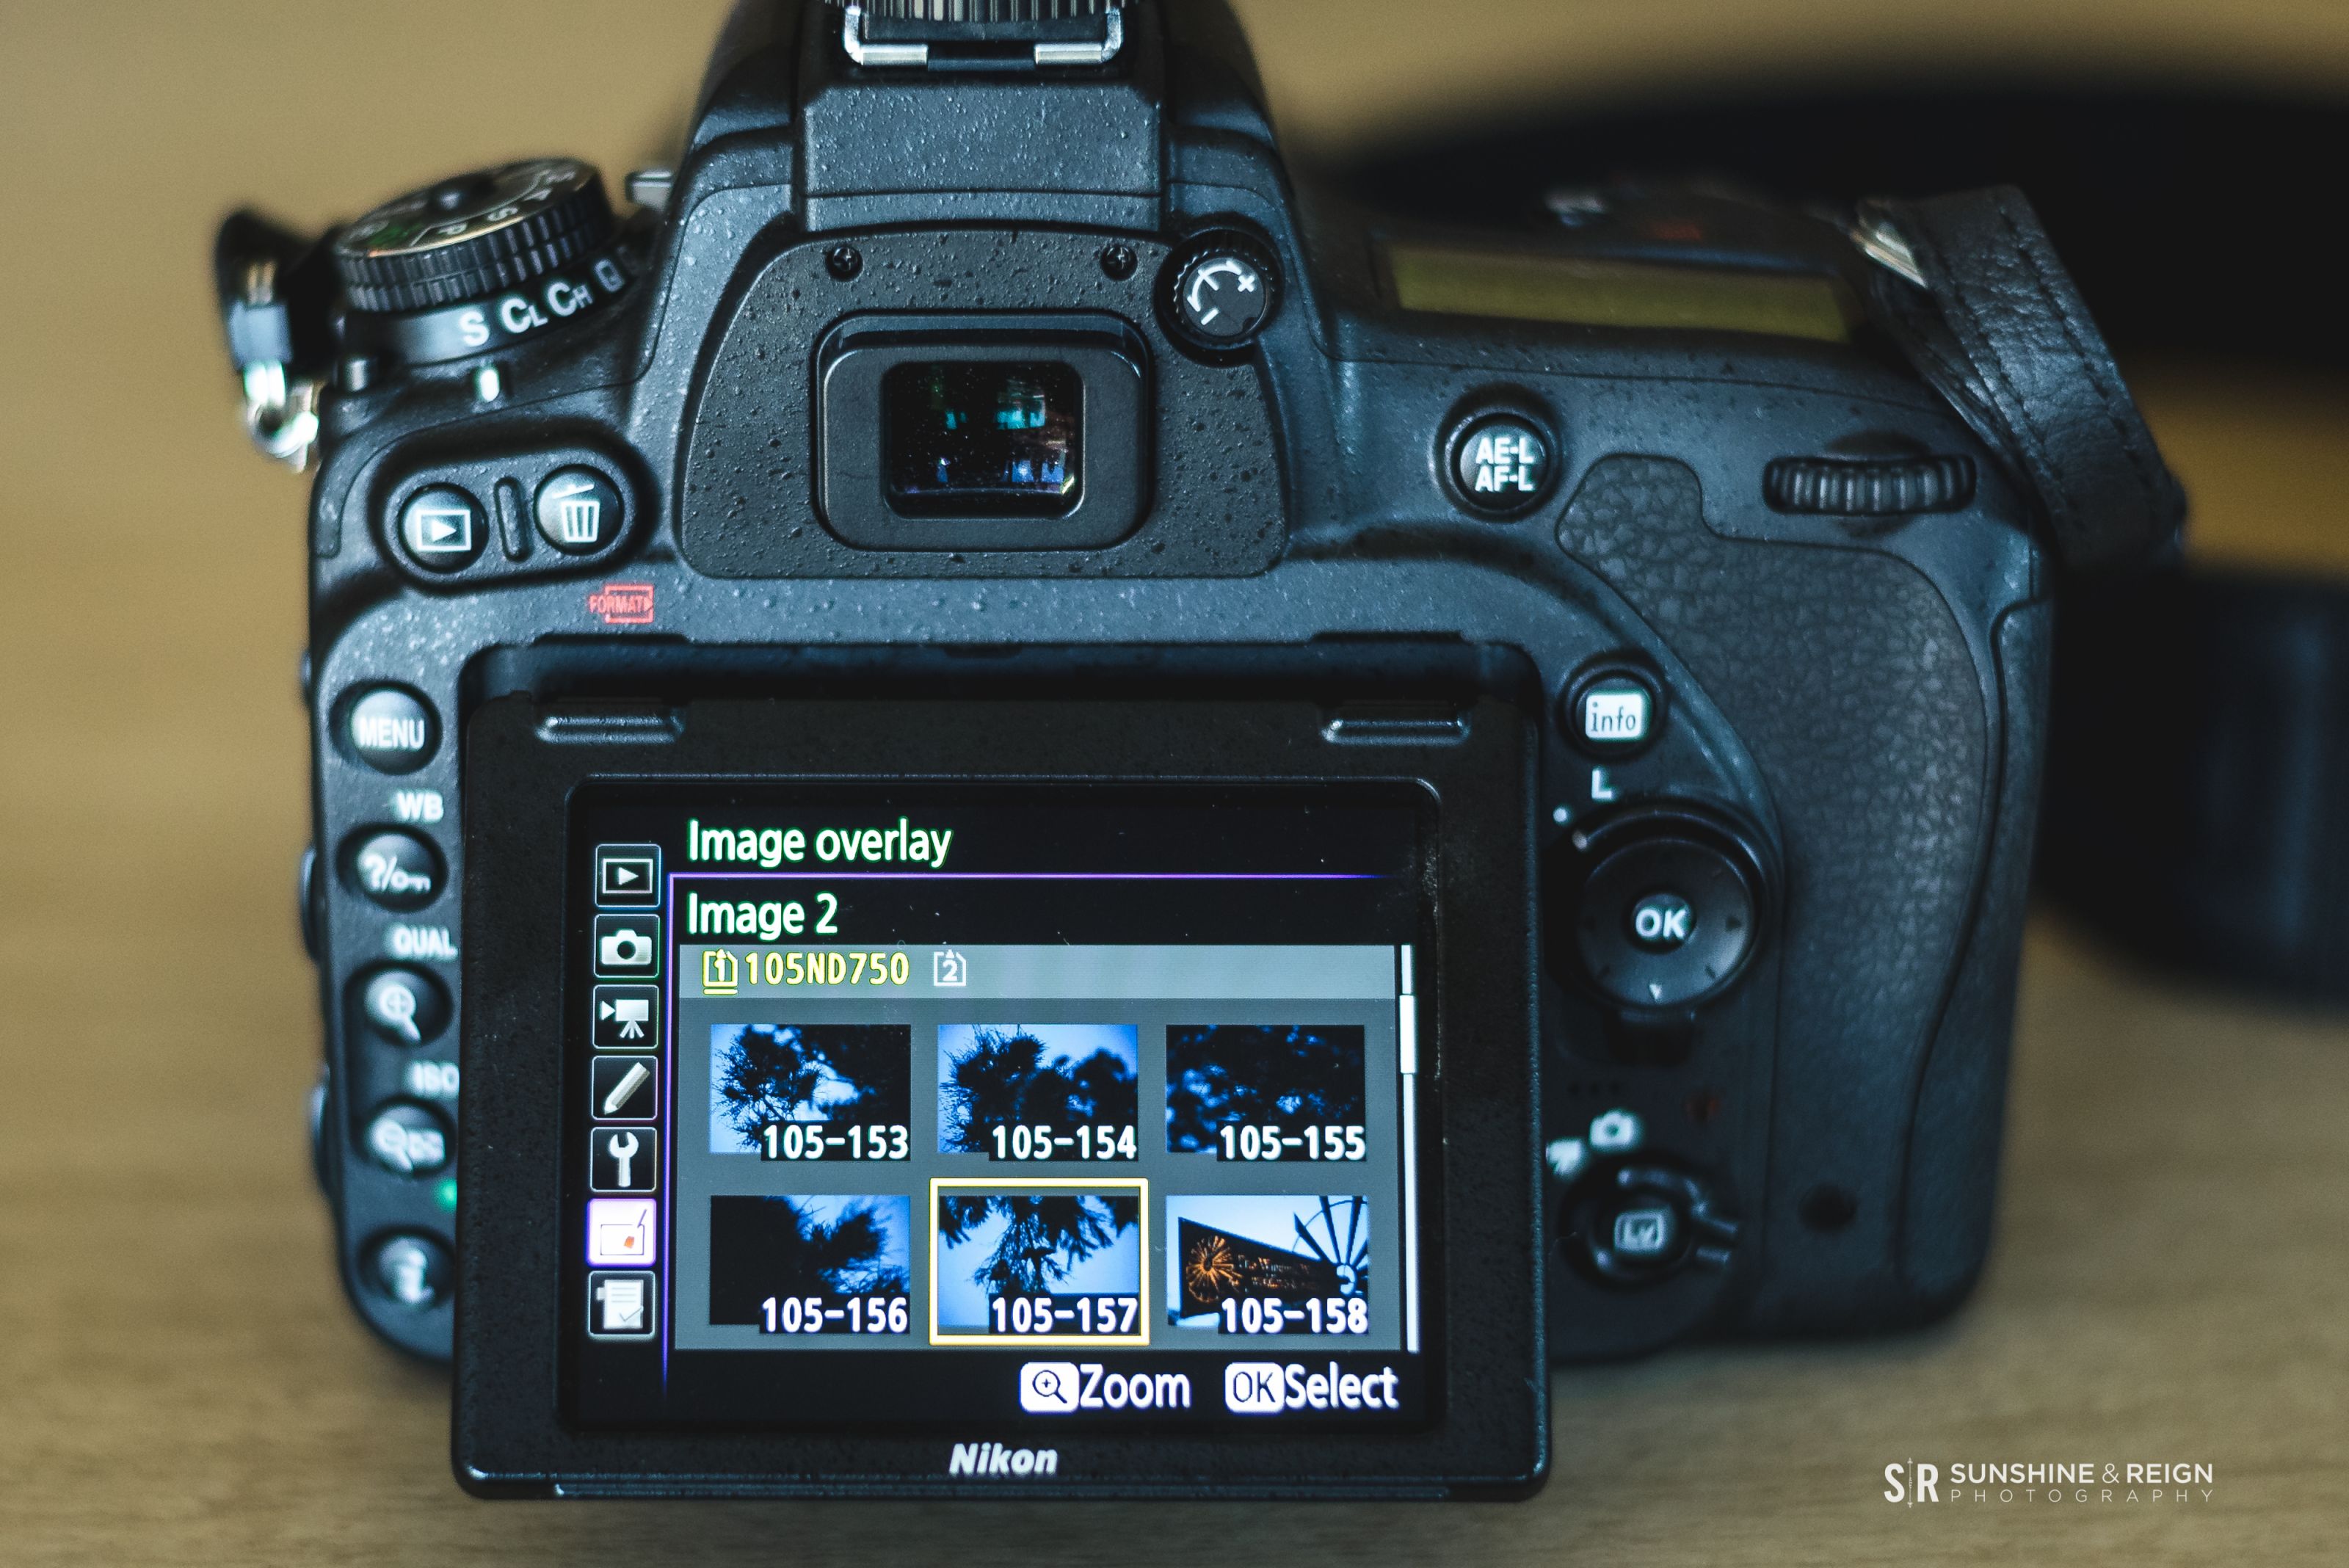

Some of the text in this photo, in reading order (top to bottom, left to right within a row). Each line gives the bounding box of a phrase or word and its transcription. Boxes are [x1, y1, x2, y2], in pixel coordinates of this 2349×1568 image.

[460, 311, 490, 346] S
[1476, 438, 1534, 465] AE-L
[1475, 466, 1535, 492] AF-L
[589, 595, 644, 613] FORMAT
[359, 718, 425, 750] MENU
[1590, 701, 1637, 733] info
[1591, 768, 1613, 800] L
[396, 790, 444, 821] WB
[688, 816, 954, 868] Image overlay
[687, 891, 838, 941] Image 2
[1635, 908, 1687, 939] OK
[745, 952, 910, 985] 105ND750
[763, 1125, 909, 1159] 105-153
[992, 1125, 1137, 1159] 105-154
[1221, 1125, 1366, 1159] 105-155
[761, 1296, 908, 1332] 105-156
[992, 1296, 1139, 1332] 105-157
[1221, 1296, 1368, 1333] 105-158
[1080, 1363, 1191, 1409] Zoom
[1232, 1361, 1399, 1409] OK Select
[950, 1443, 1058, 1476] Nikon
